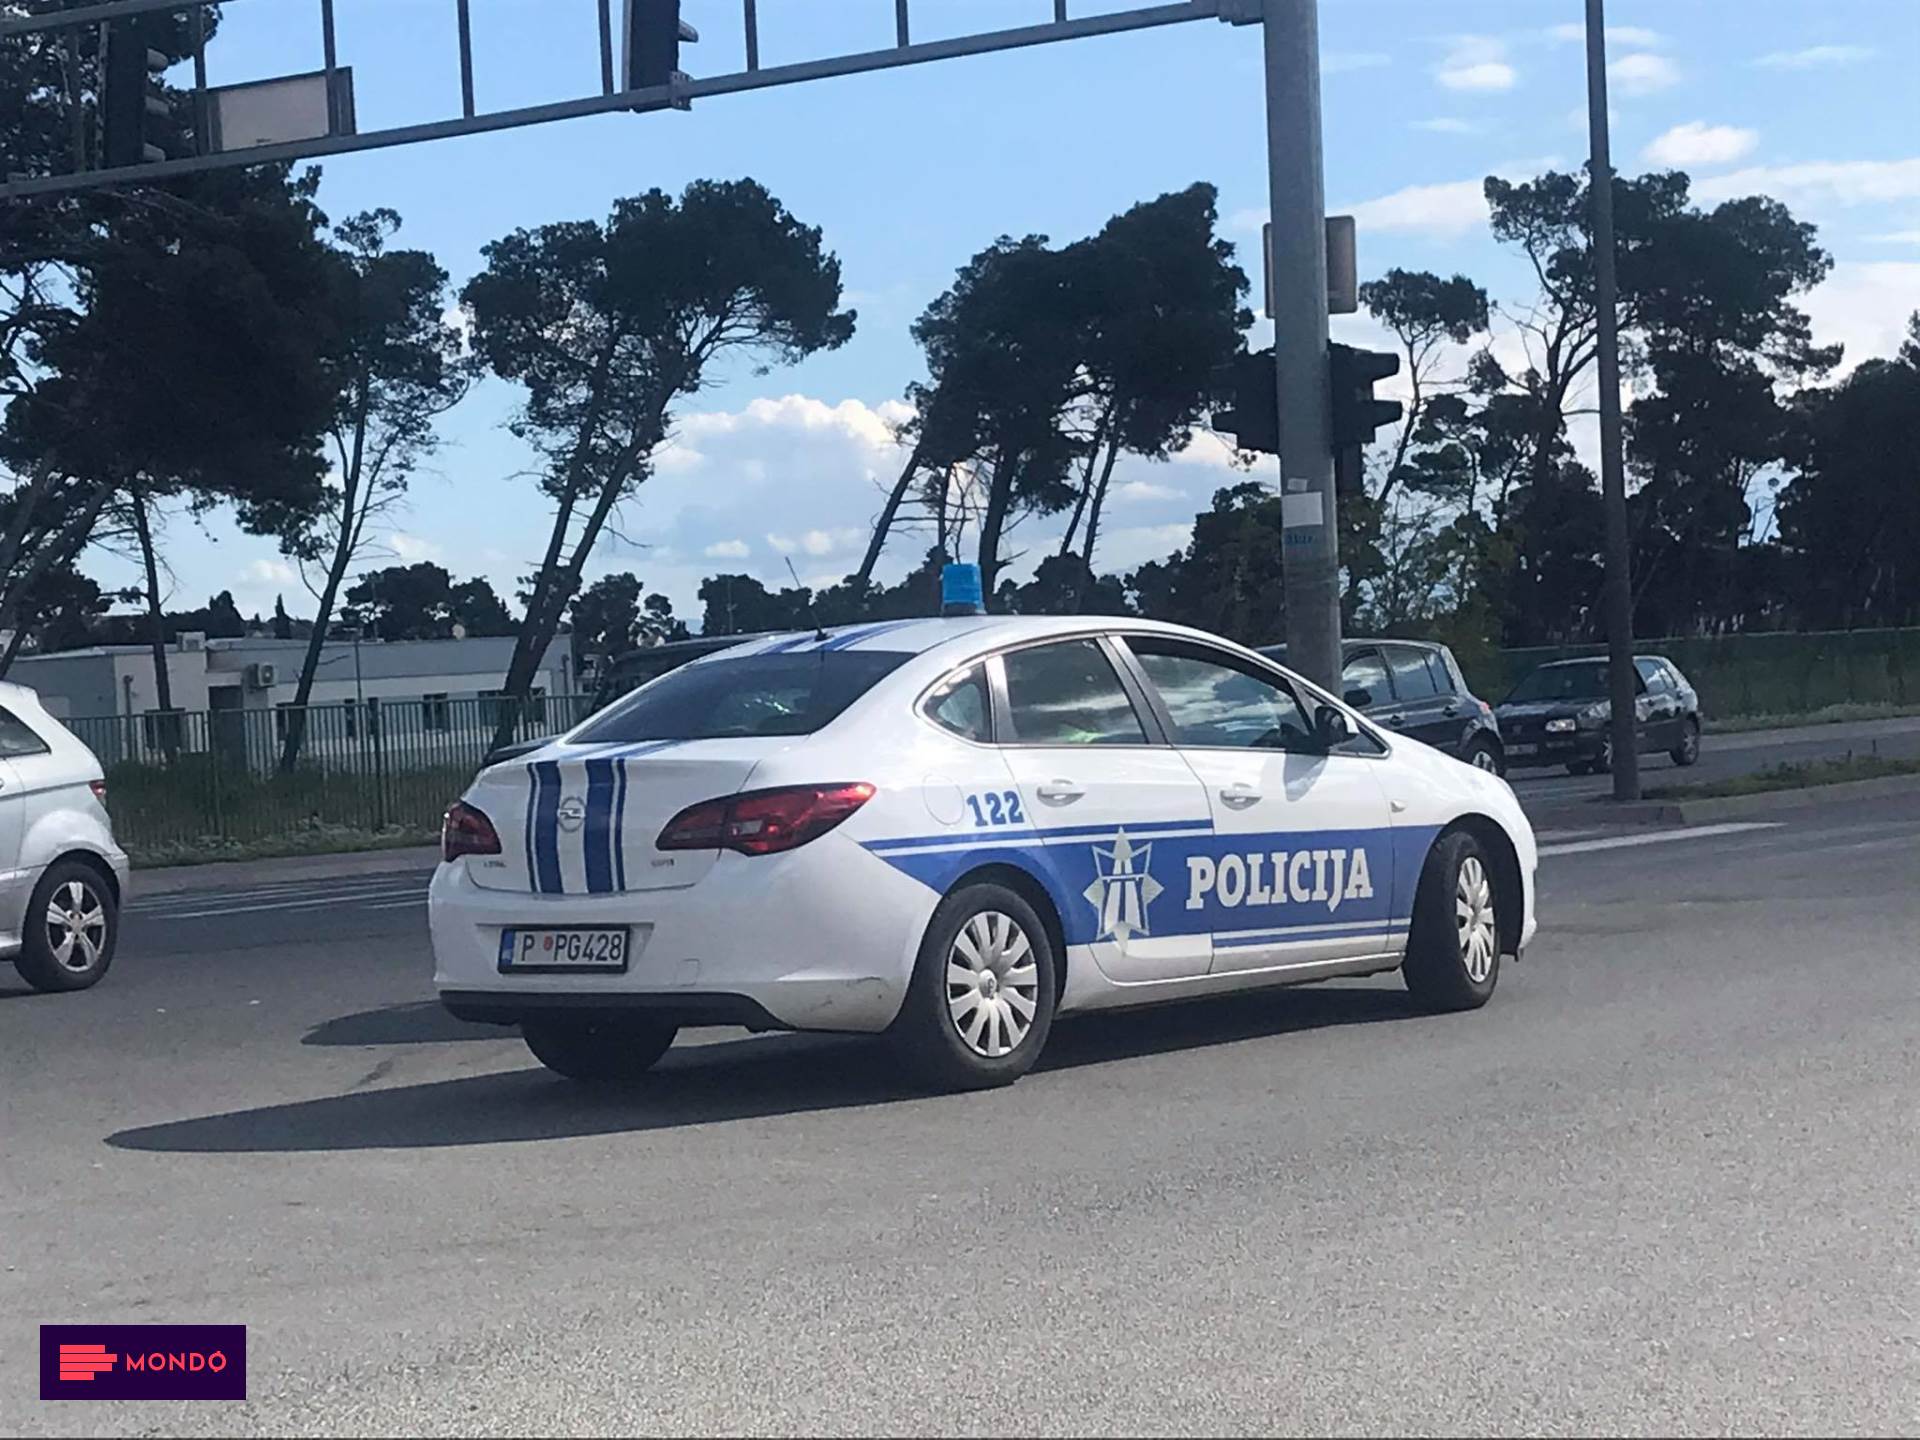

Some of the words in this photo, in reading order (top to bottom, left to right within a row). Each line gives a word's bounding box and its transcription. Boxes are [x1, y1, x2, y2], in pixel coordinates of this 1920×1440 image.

[966, 790, 1025, 827] 122
[1185, 848, 1374, 913] POLICIJA
[521, 934, 536, 962] P
[553, 933, 623, 962] PG428
